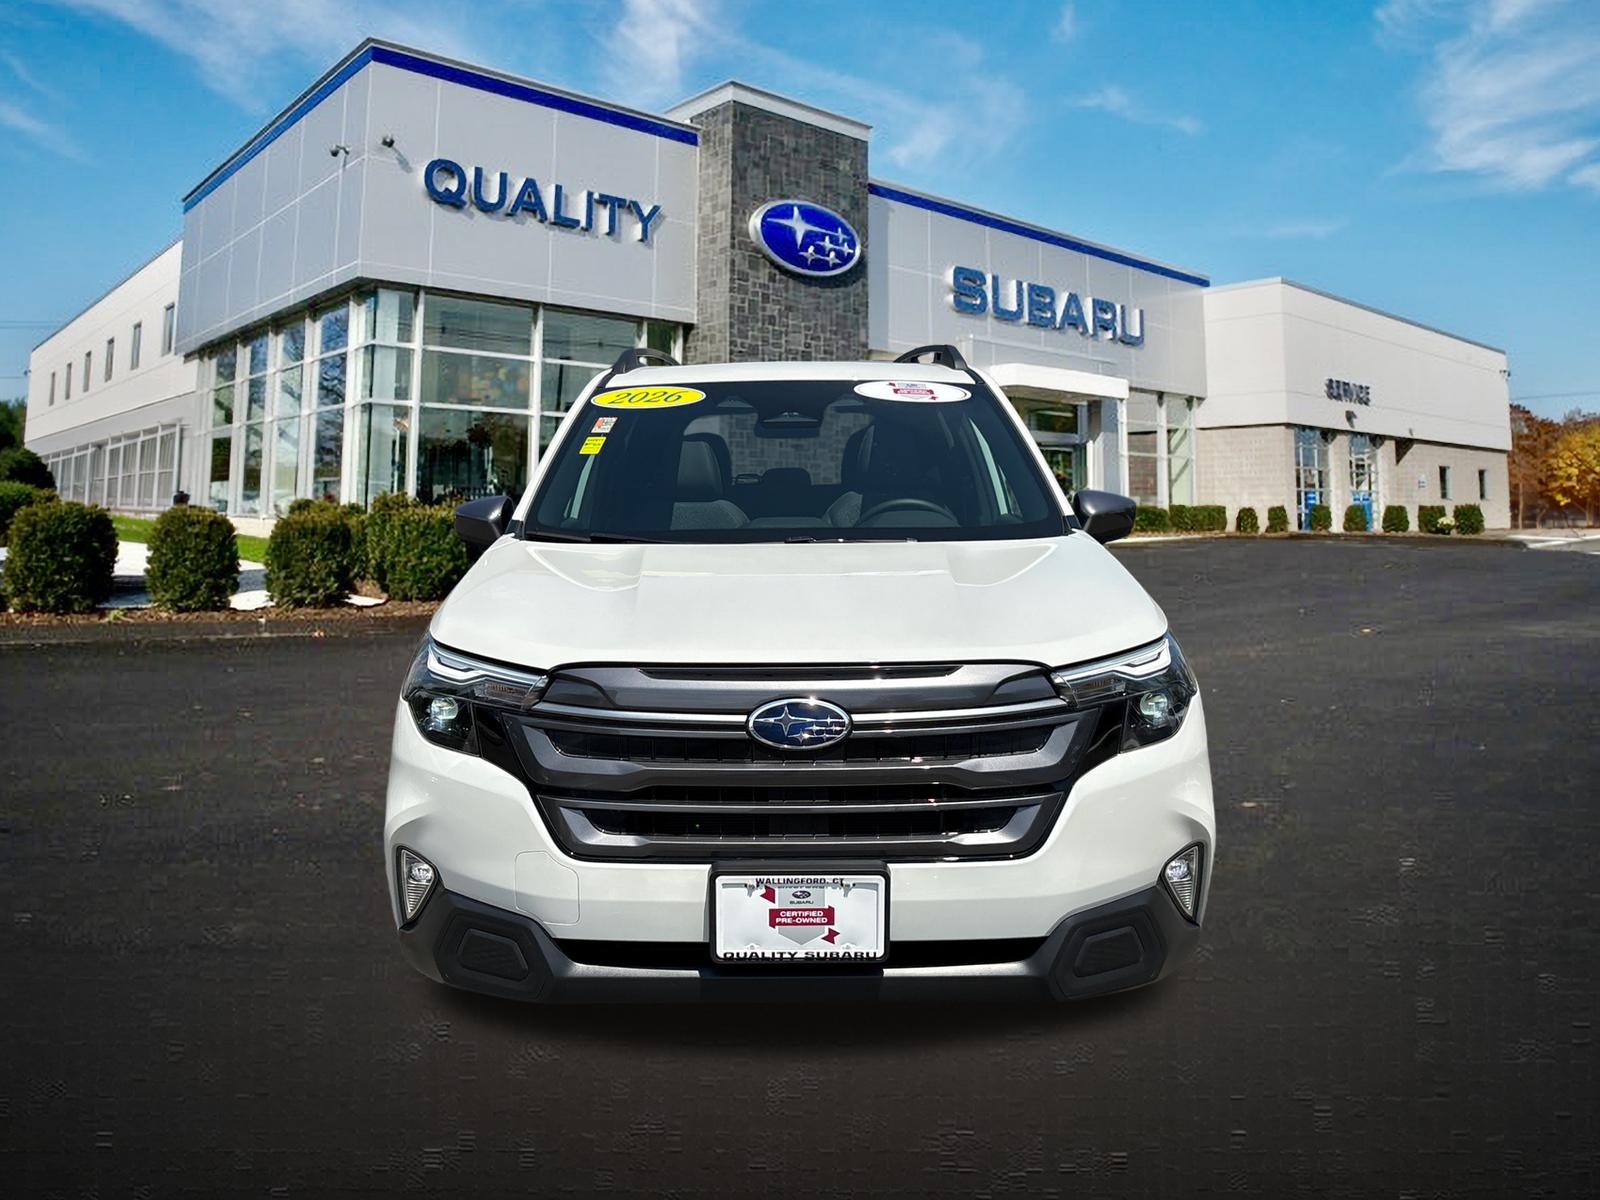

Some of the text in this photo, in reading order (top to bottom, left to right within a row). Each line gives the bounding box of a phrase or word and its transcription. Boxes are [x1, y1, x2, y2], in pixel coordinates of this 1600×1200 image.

[423, 158, 662, 243] QUALITY
[949, 265, 1146, 347] SUBARU
[607, 390, 688, 405] 2026
[1325, 378, 1371, 406] SERVICE
[723, 951, 877, 959] QUALITY SUBARU
